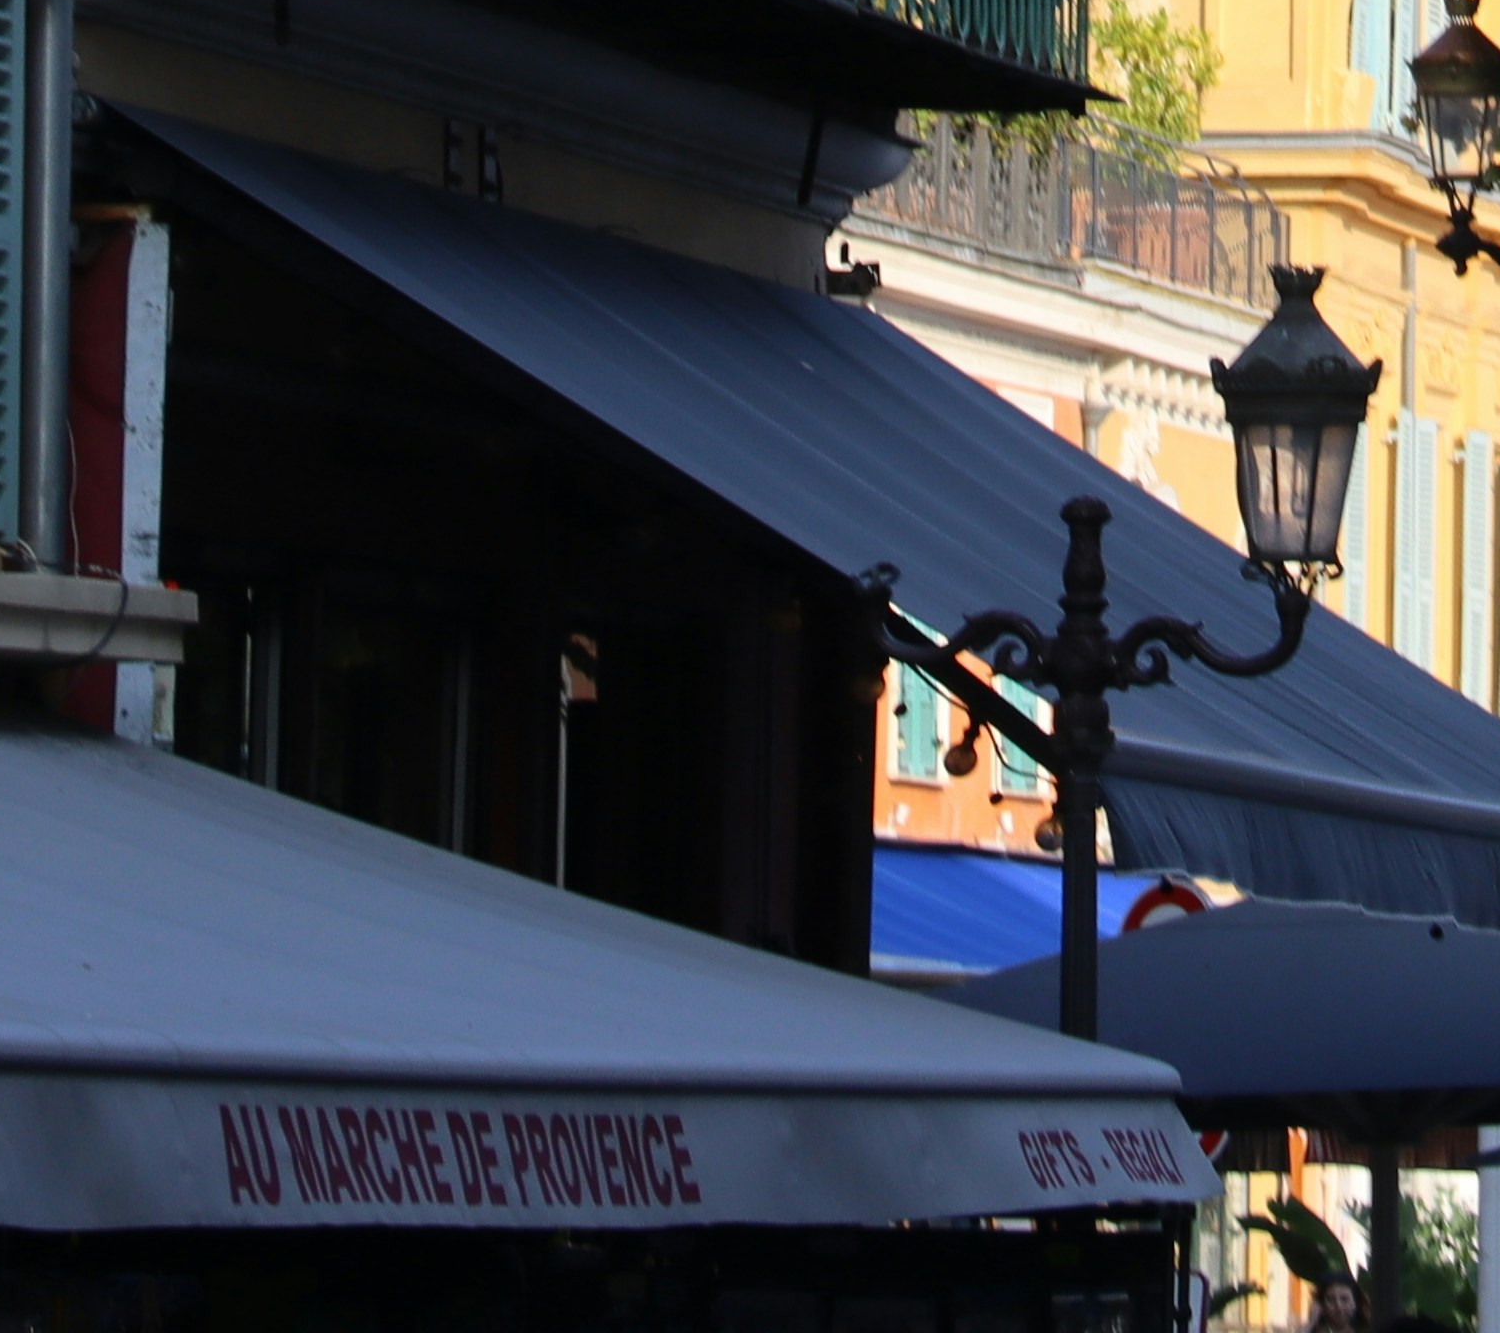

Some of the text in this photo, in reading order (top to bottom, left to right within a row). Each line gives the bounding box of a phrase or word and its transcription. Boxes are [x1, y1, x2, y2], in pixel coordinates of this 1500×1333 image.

[220, 1103, 701, 1207] AU MARCHE DE PROVENCE
[1017, 1129, 1097, 1190] GIFTS
[1102, 1128, 1186, 1186] REGALI
